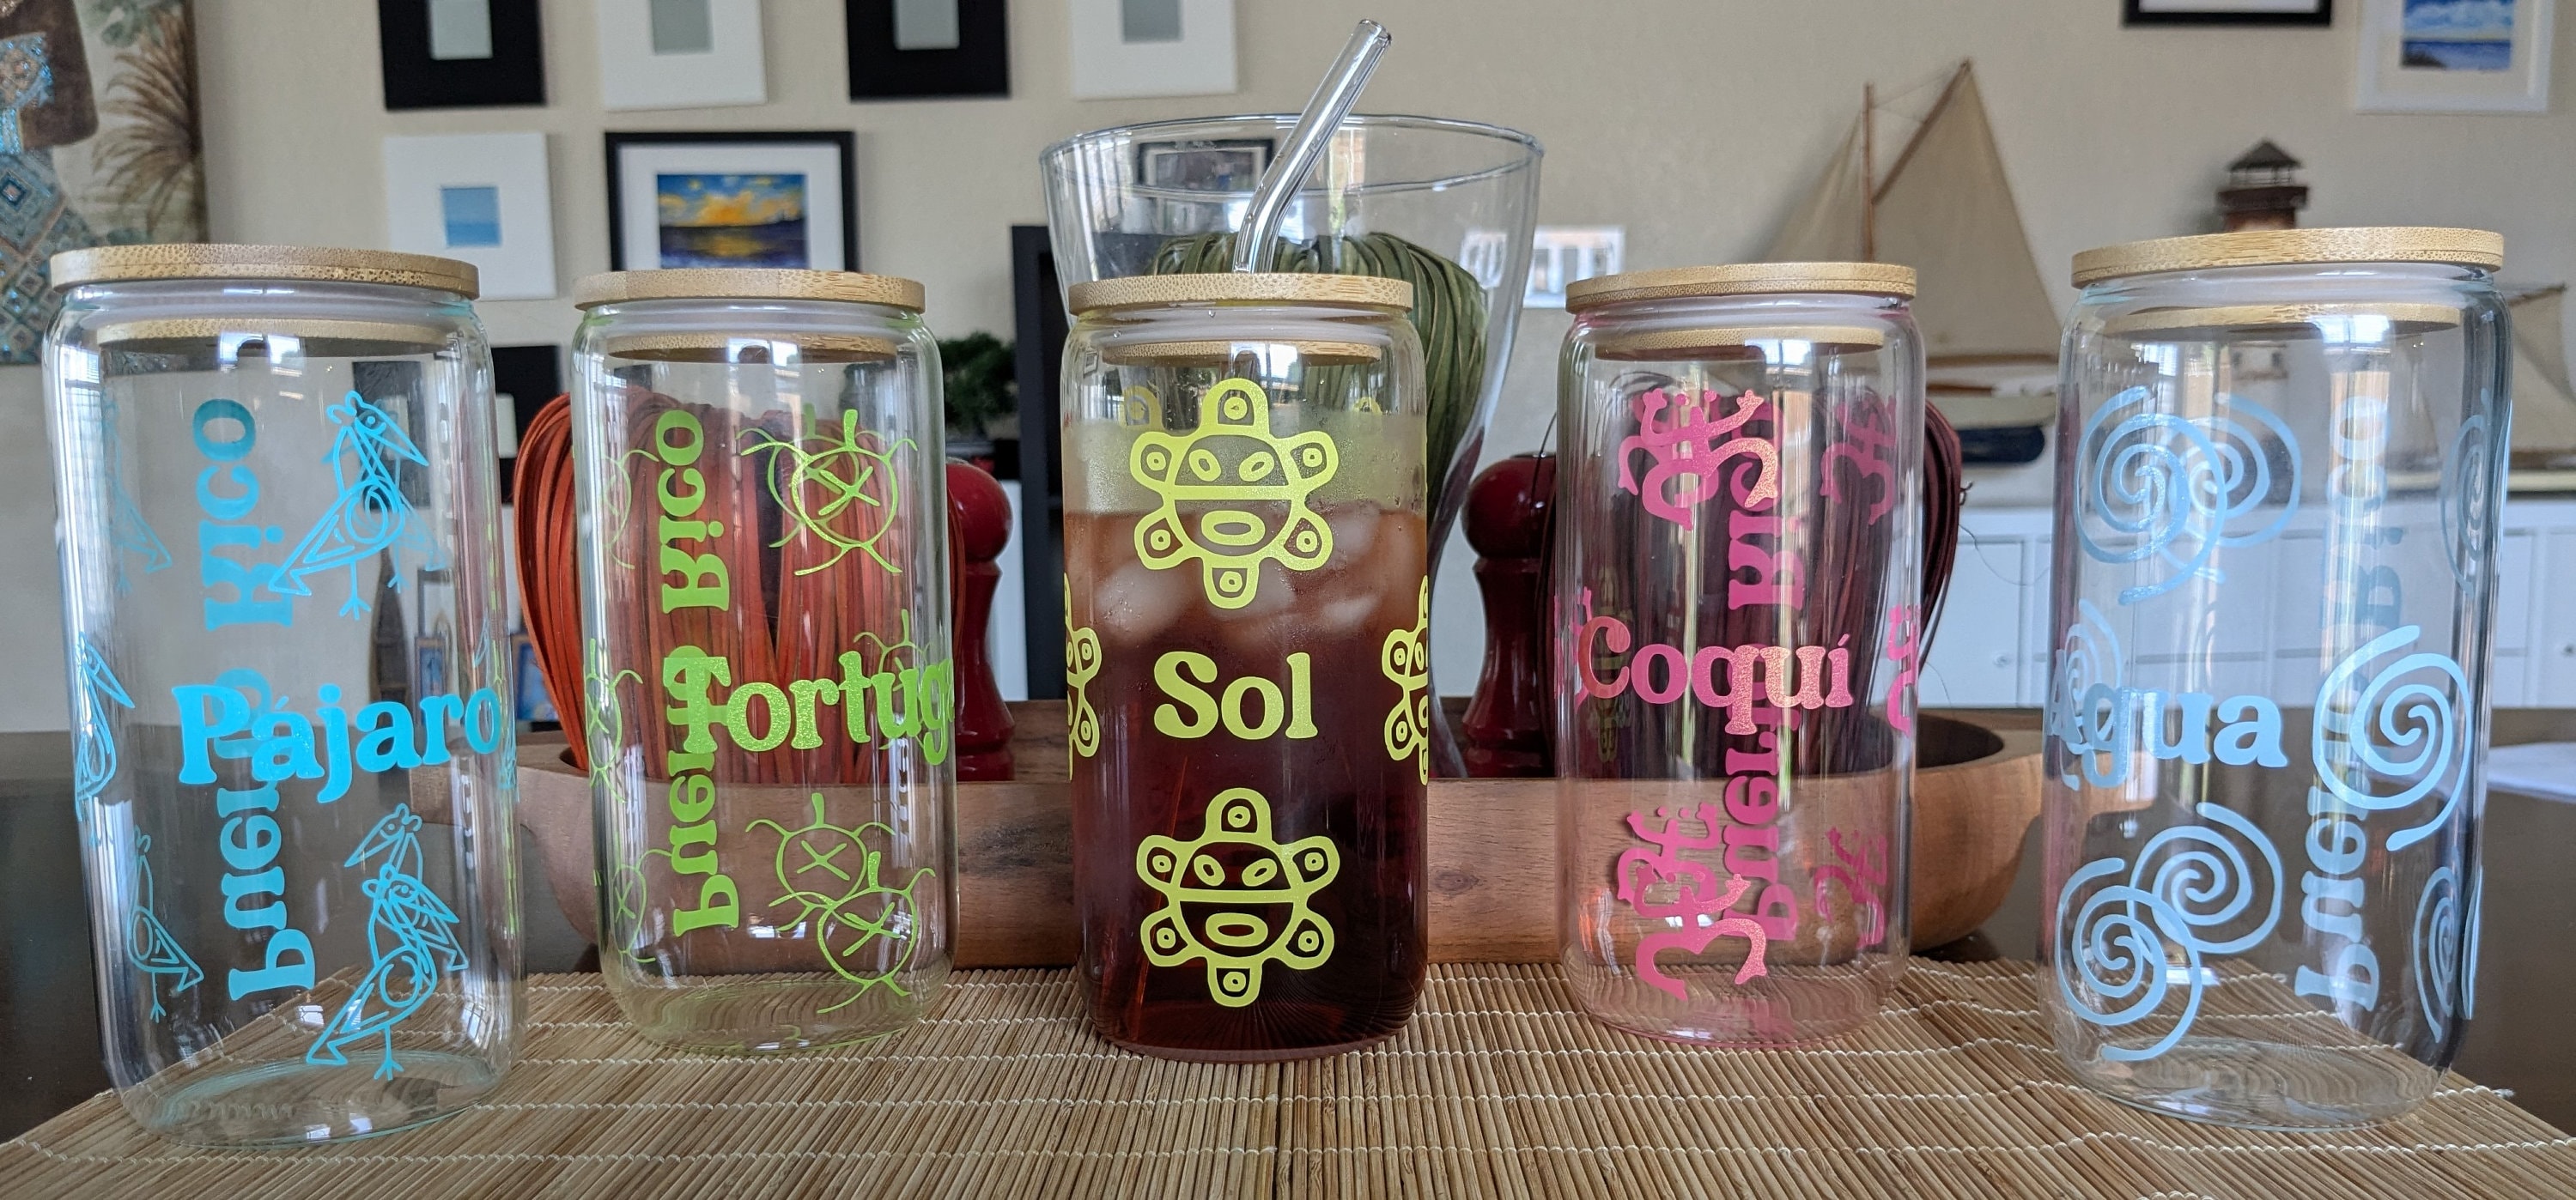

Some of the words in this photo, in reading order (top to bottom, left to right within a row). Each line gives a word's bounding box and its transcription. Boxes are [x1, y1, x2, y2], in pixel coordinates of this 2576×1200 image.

[662, 650, 955, 766] Tortug
[1152, 652, 1318, 739] Sol
[1578, 615, 1855, 735] Coquí
[172, 683, 502, 803] Pájaro
